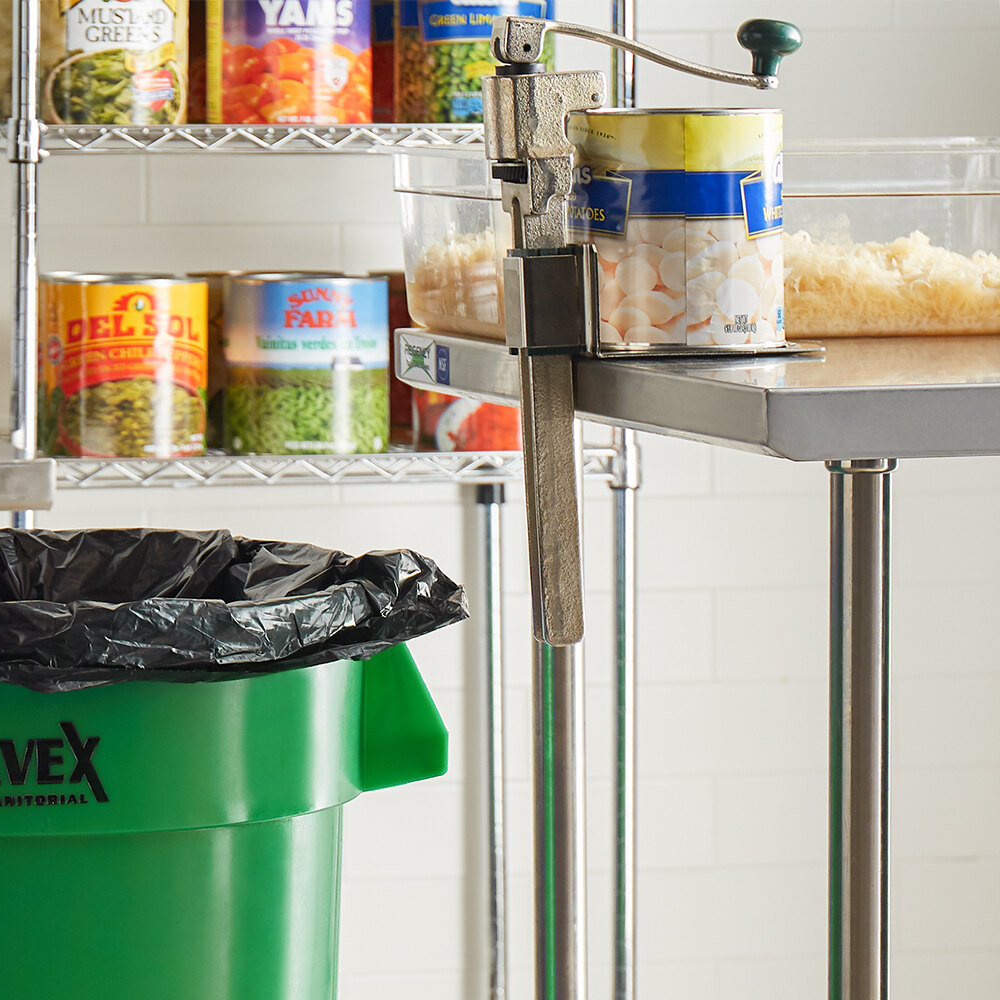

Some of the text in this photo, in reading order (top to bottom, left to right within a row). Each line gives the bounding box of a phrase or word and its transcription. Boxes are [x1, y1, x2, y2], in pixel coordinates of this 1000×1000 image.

[77, 8, 167, 24] MUSTRD
[258, 0, 354, 26] YAMS
[429, 14, 467, 27] GREEN
[85, 26, 161, 42] GREES
[567, 206, 606, 221] OTATOES
[66, 313, 199, 343] DEL SOL
